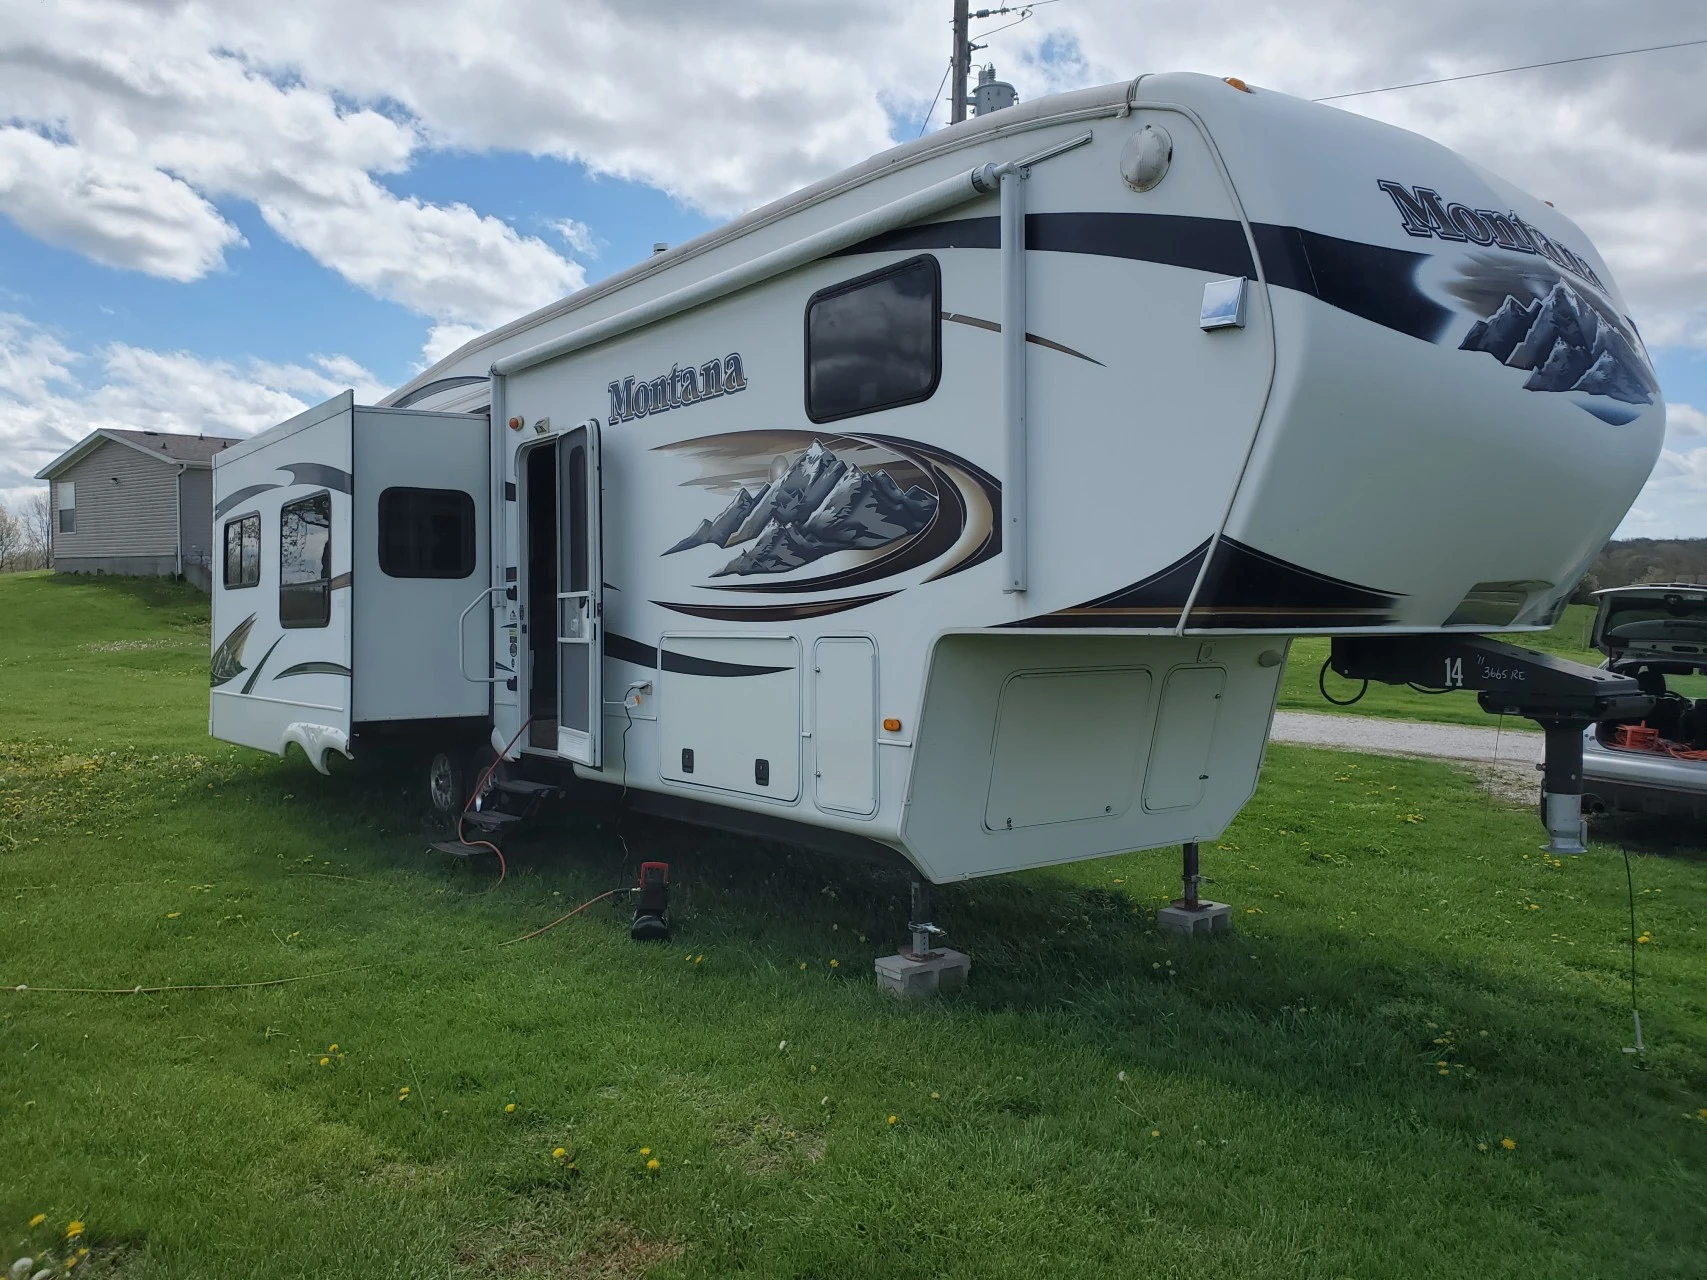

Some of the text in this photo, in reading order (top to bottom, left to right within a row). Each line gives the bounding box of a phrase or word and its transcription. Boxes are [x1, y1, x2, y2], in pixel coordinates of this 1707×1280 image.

[1377, 179, 1608, 295] Montana
[608, 352, 748, 426] Montana
[1444, 657, 1463, 686] 14
[1481, 666, 1508, 680] 3665
